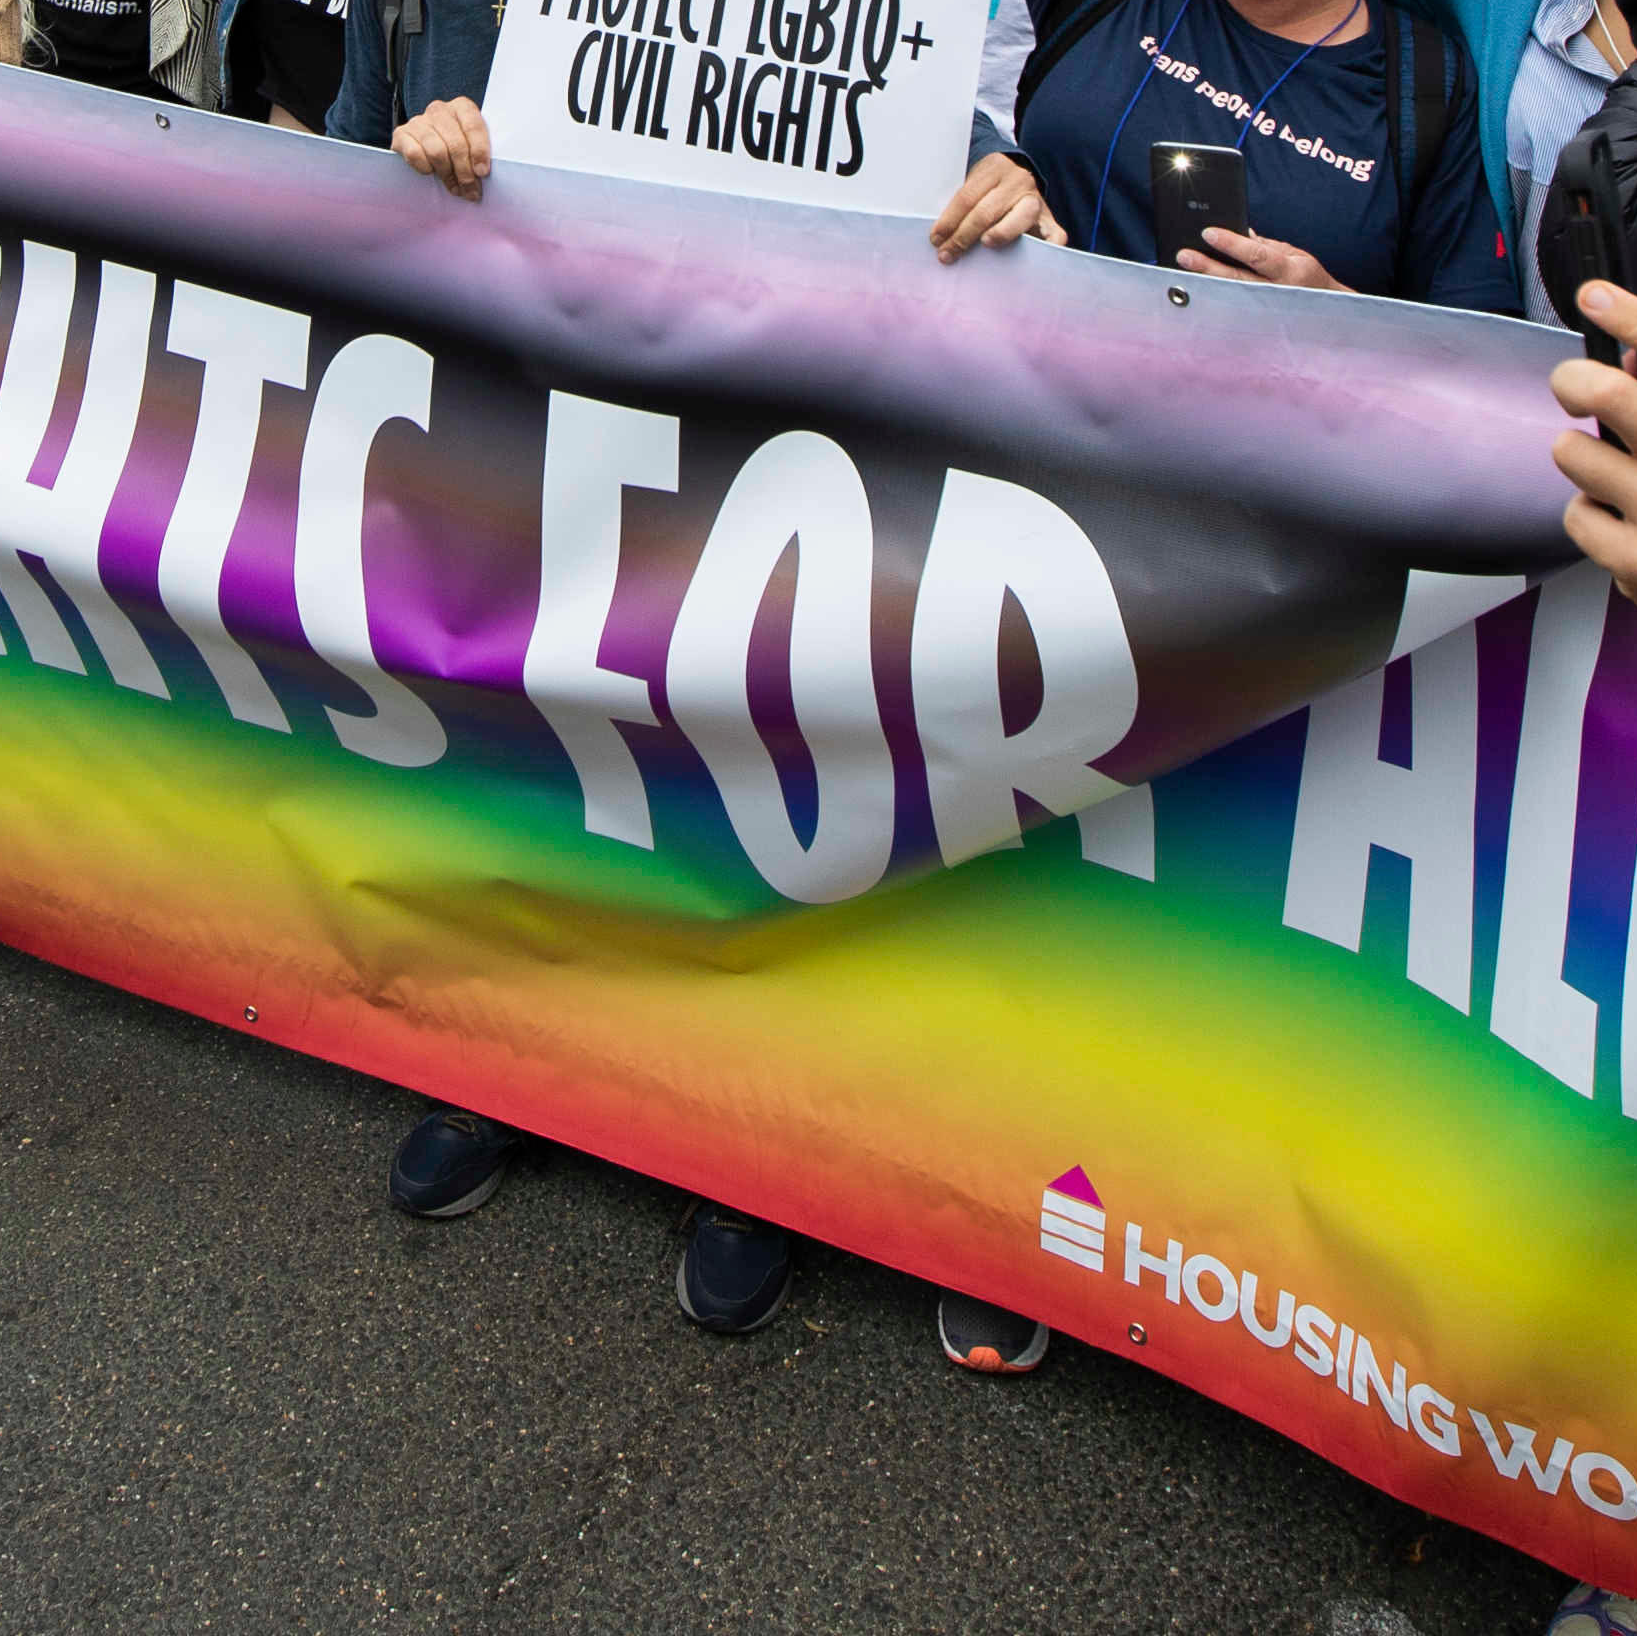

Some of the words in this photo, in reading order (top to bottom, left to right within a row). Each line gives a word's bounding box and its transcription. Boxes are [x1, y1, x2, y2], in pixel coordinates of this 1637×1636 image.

[566, 30, 675, 141] CIVIL
[686, 51, 873, 177] RIGHTS
[1139, 35, 1200, 84] trans
[1196, 80, 1275, 137] people
[1280, 124, 1375, 182] belong
[524, 390, 1156, 909] FOR
[1123, 1221, 1464, 1458] HOUSING
